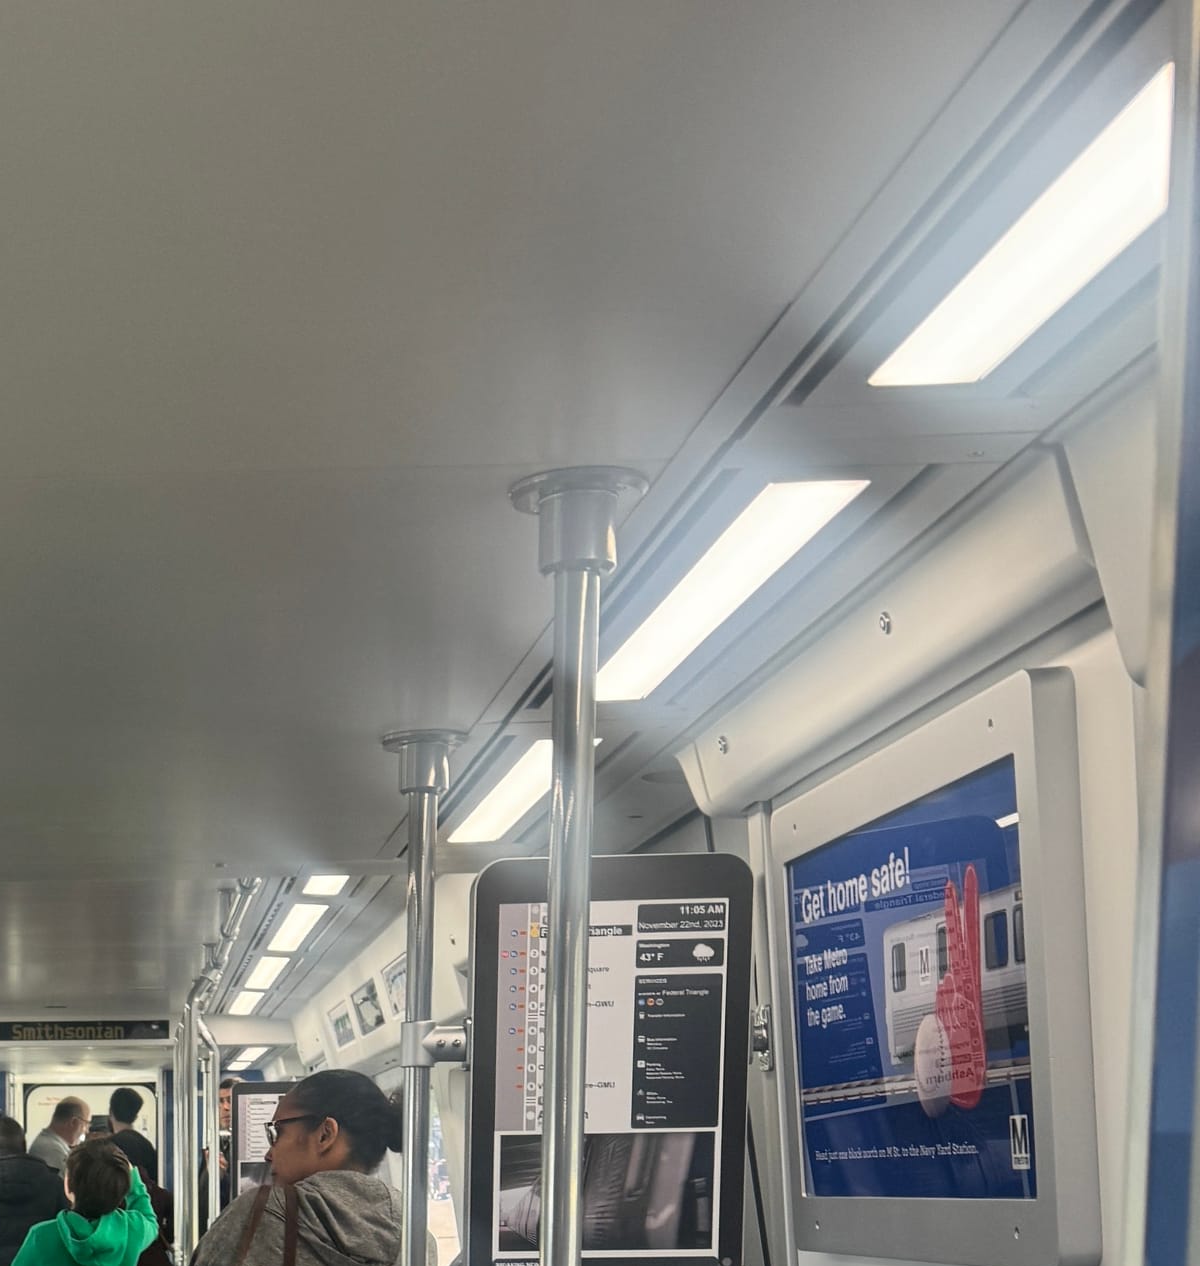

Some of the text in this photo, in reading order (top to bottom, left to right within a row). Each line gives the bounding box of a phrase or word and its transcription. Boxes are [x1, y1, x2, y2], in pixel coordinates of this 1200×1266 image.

[801, 846, 910, 924] Get home safe!
[680, 904, 724, 915] 11:05 AM
[639, 919, 723, 929] November 22nd, 2023
[804, 947, 848, 975] Take Metro
[806, 974, 849, 1000] home from
[807, 1003, 846, 1028] the game.
[11, 1022, 125, 1041] Smithsonian
[1011, 1118, 1028, 1155] M
